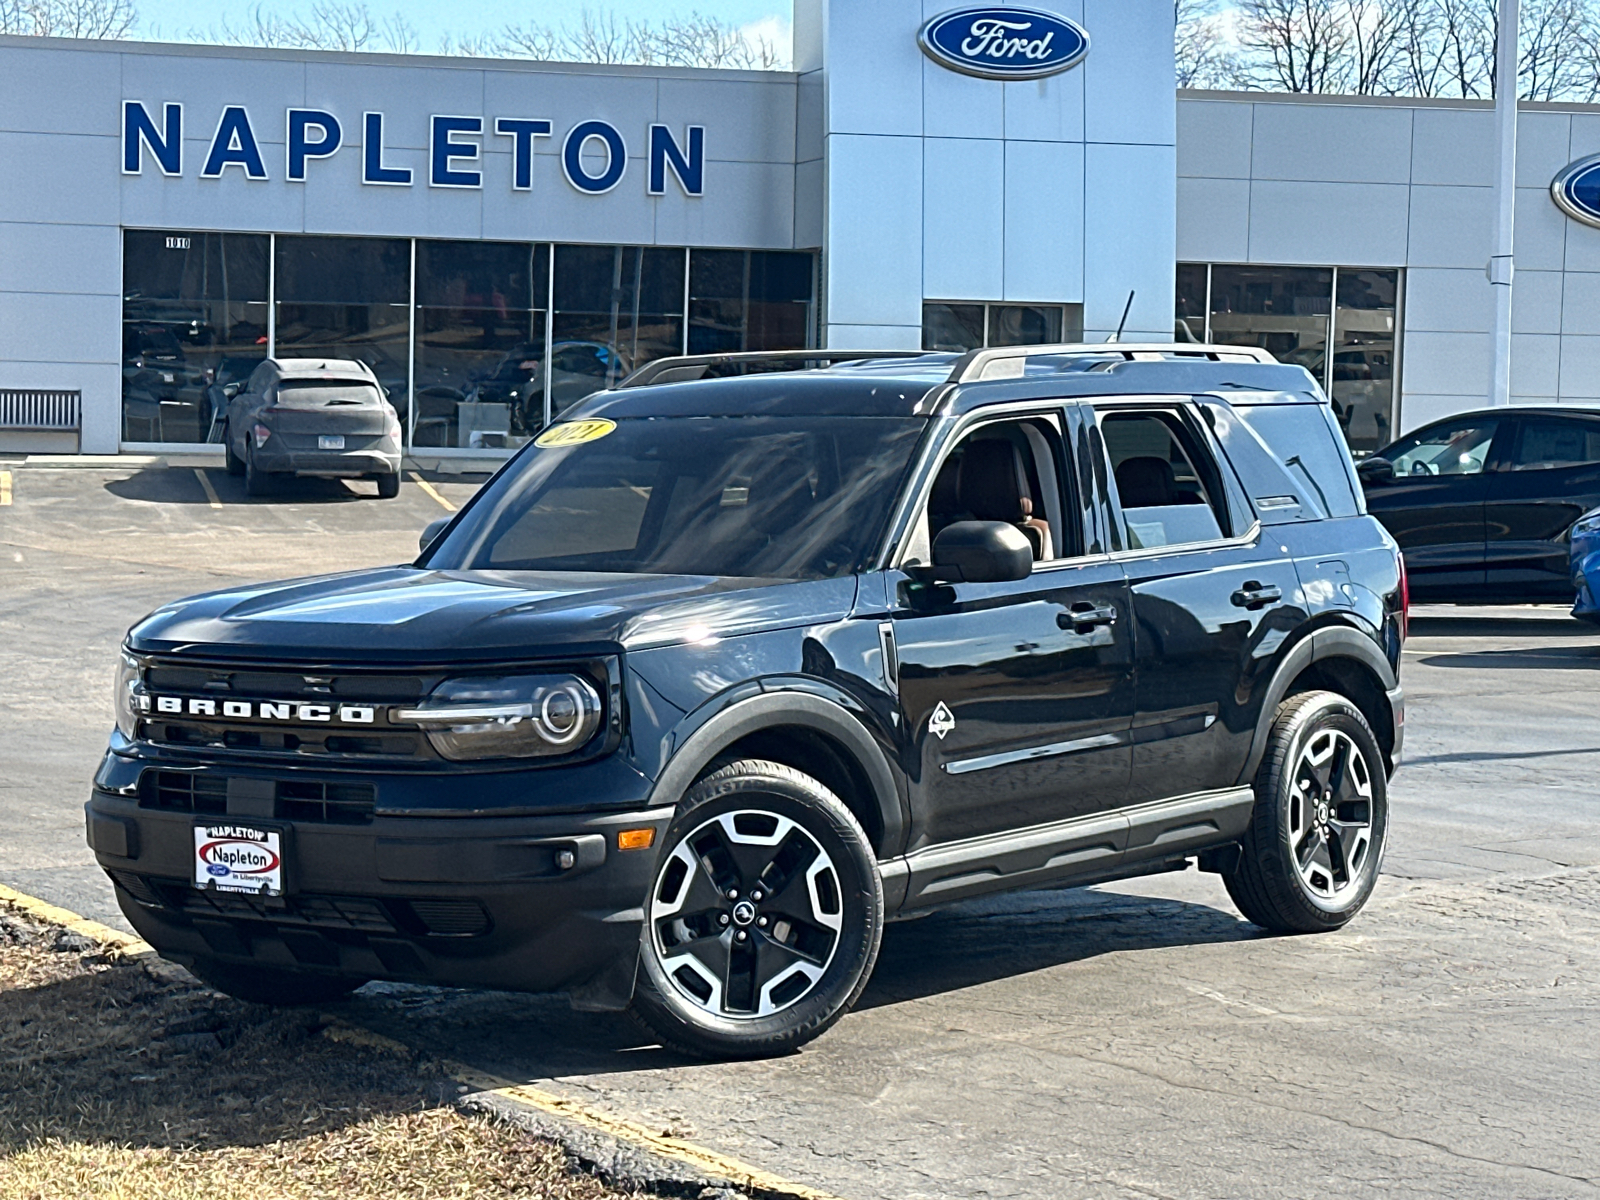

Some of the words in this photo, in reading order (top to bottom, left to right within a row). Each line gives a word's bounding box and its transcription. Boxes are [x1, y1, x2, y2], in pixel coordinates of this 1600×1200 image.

[961, 19, 1054, 59] Ford
[121, 99, 706, 197] NAPLETON
[165, 236, 190, 249] 1010
[542, 423, 606, 444] 2021
[157, 696, 375, 723] BRONCO
[211, 826, 265, 841] NAPLETON
[213, 845, 267, 867] Napleton
[240, 873, 274, 884] Libertyville
